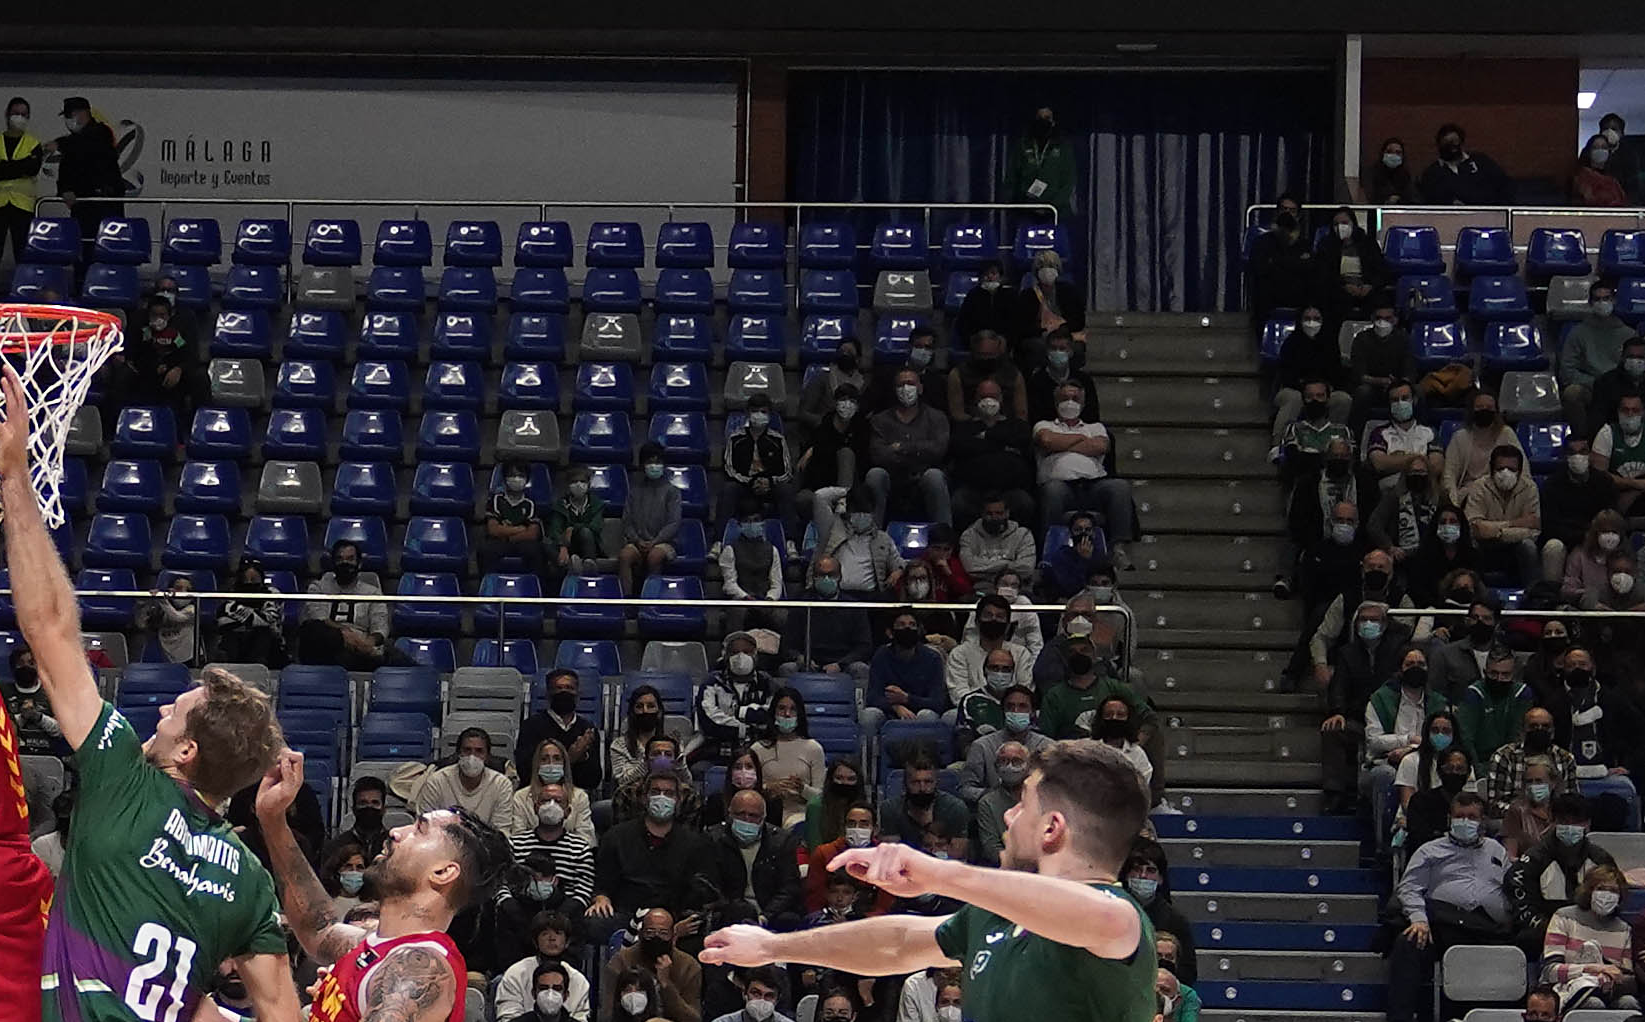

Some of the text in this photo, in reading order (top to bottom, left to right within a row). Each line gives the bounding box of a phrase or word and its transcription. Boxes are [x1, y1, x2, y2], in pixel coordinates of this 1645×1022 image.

[160, 134, 271, 162] MÁLAGA
[159, 168, 271, 189] Deporte y Eventos
